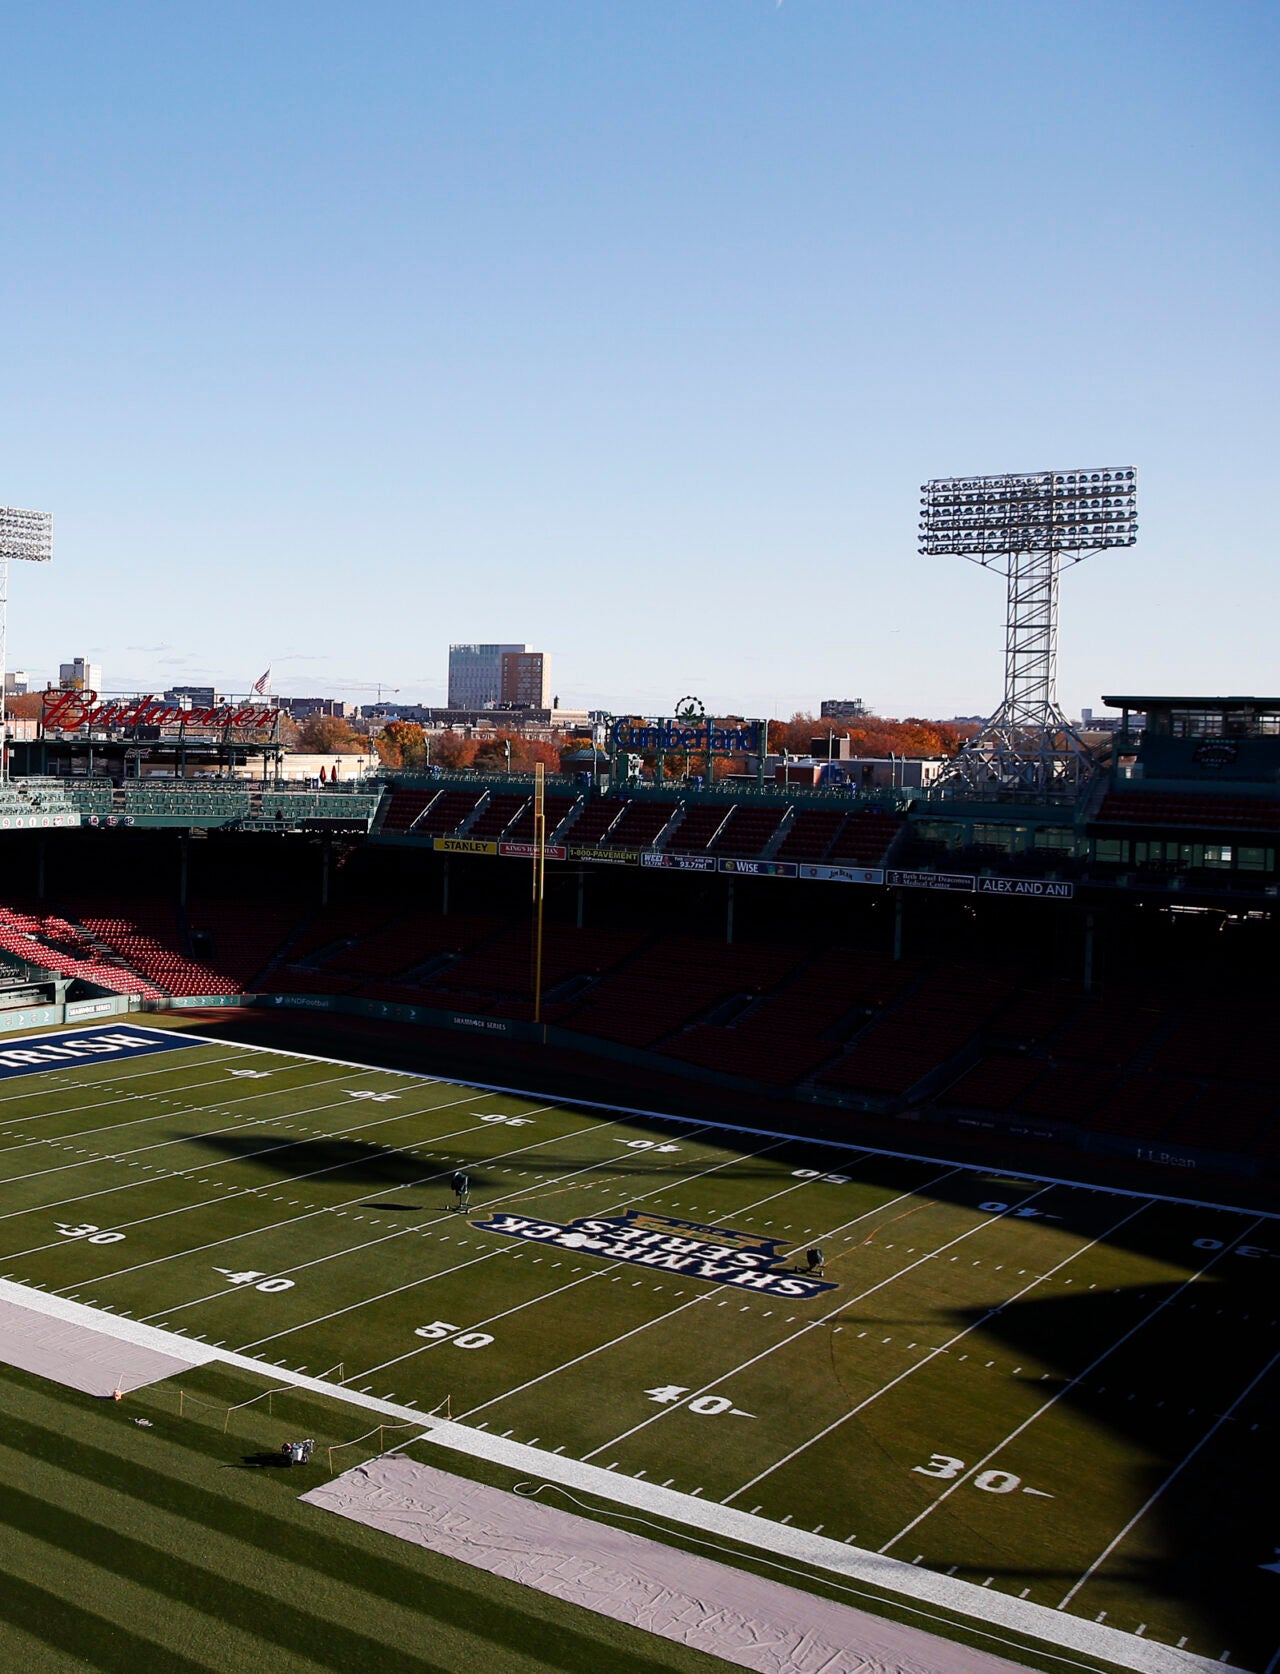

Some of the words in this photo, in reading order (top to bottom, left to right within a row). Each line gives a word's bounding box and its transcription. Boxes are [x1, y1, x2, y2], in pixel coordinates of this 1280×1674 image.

[42, 689, 281, 732] Budweiser
[613, 718, 758, 750] Cumberland
[444, 841, 488, 852] STANLEY
[570, 849, 638, 860] 1-800-PAVEMENT
[983, 880, 1012, 891] ALEX
[1015, 882, 1043, 894] AND
[1046, 884, 1068, 896] ANI
[57, 1223, 126, 1245] 30
[577, 1220, 770, 1268] SERIES
[226, 1270, 296, 1293] 40
[414, 1321, 495, 1349] 50
[643, 1385, 733, 1416] 40
[912, 1454, 1021, 1494] 30
